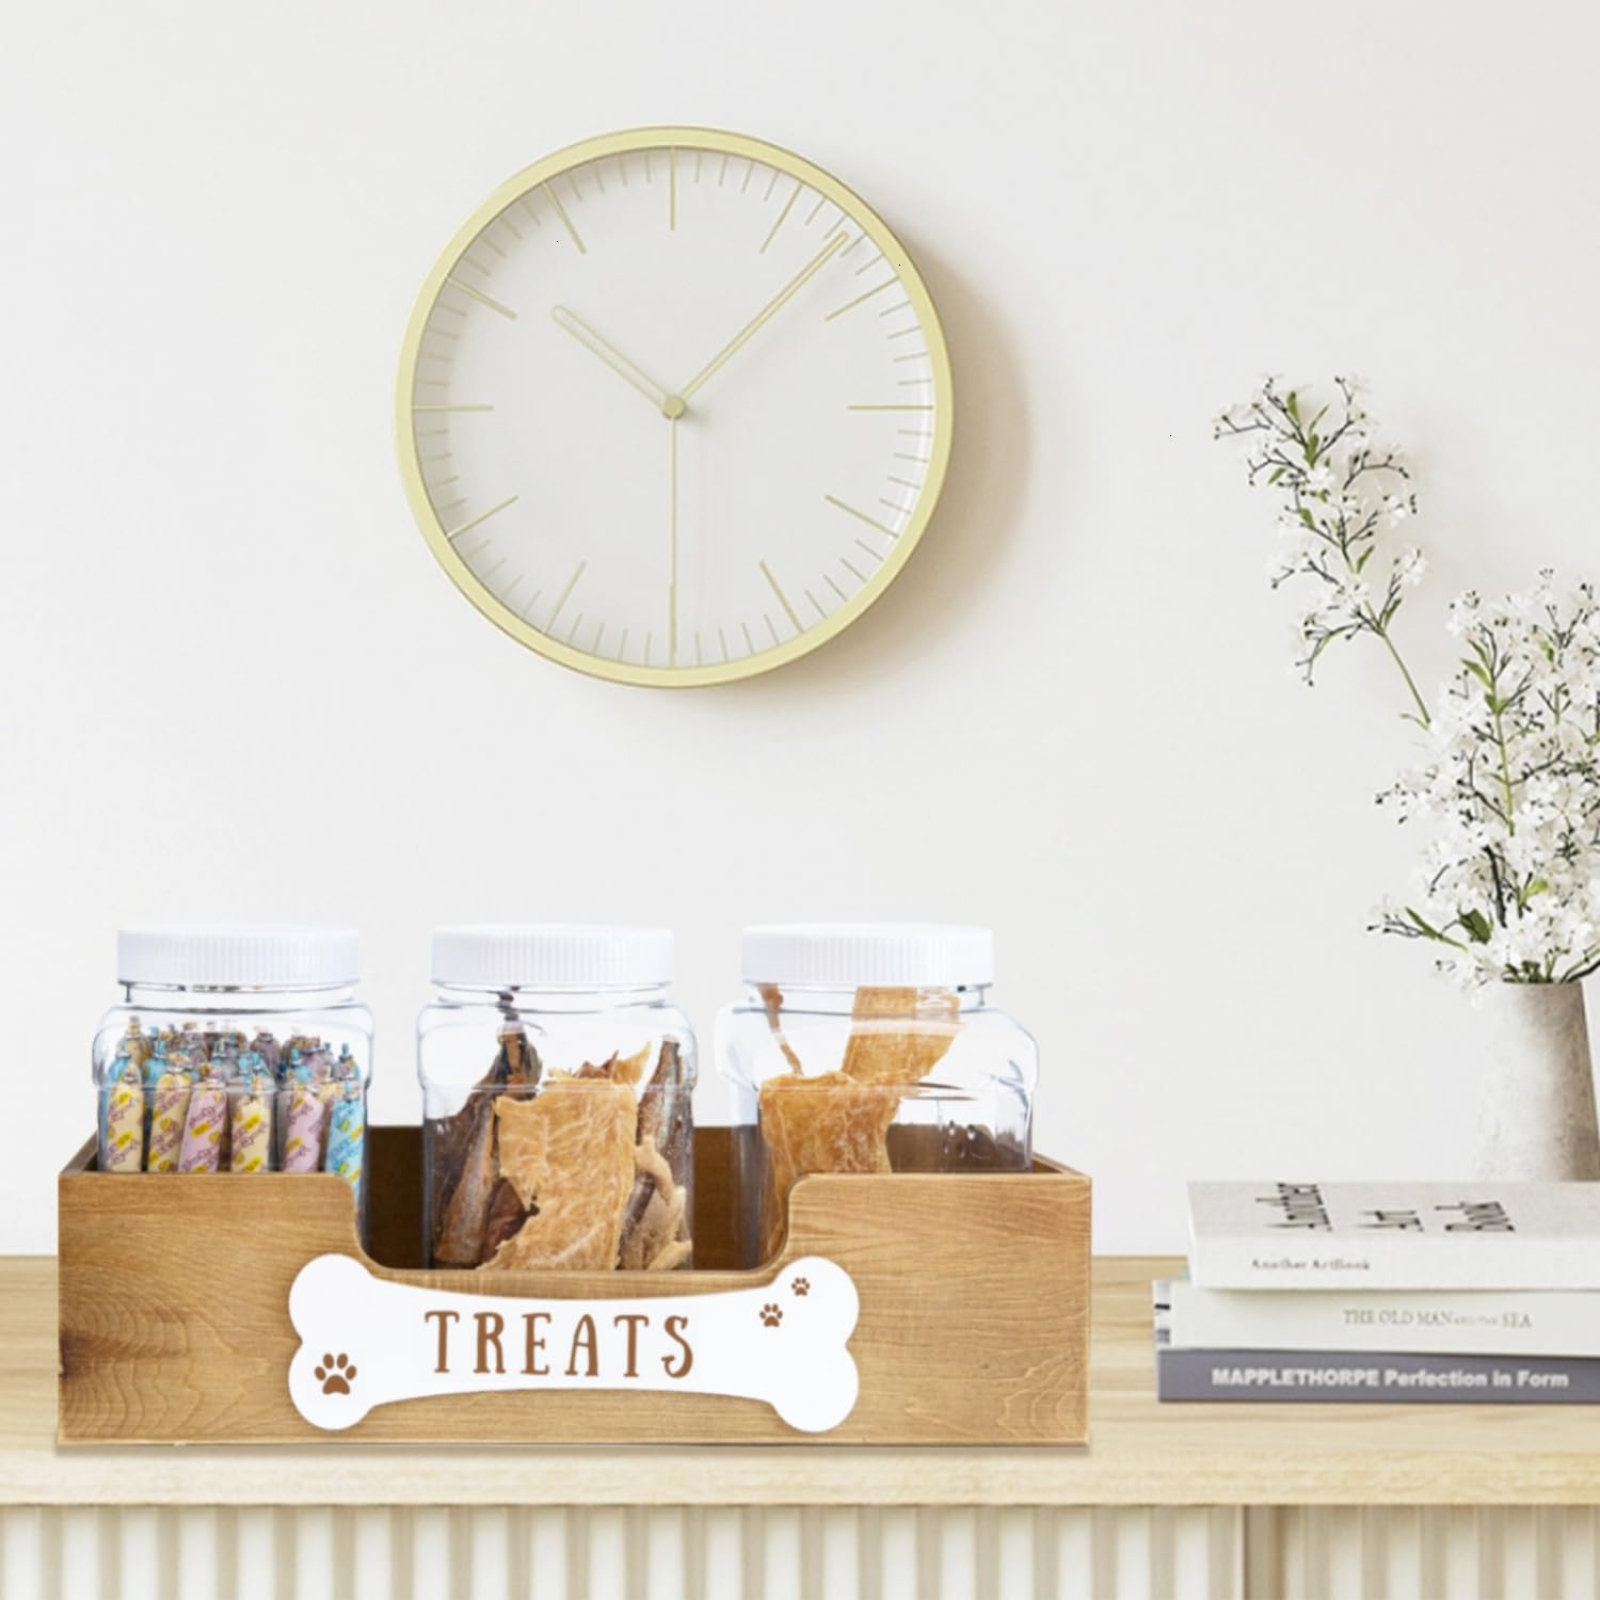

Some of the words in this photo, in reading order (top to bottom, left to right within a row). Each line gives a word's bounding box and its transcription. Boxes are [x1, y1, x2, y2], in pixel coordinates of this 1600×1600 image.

[1343, 1309, 1374, 1325] THE
[1378, 1310, 1413, 1326] OLD
[1416, 1310, 1452, 1327] MAN
[1501, 1312, 1532, 1328] SEA
[424, 1310, 694, 1379] TREATS
[1211, 1368, 1379, 1387] MAPPLETHORPE
[1384, 1368, 1488, 1388] Perfection
[1517, 1369, 1570, 1389] Form
